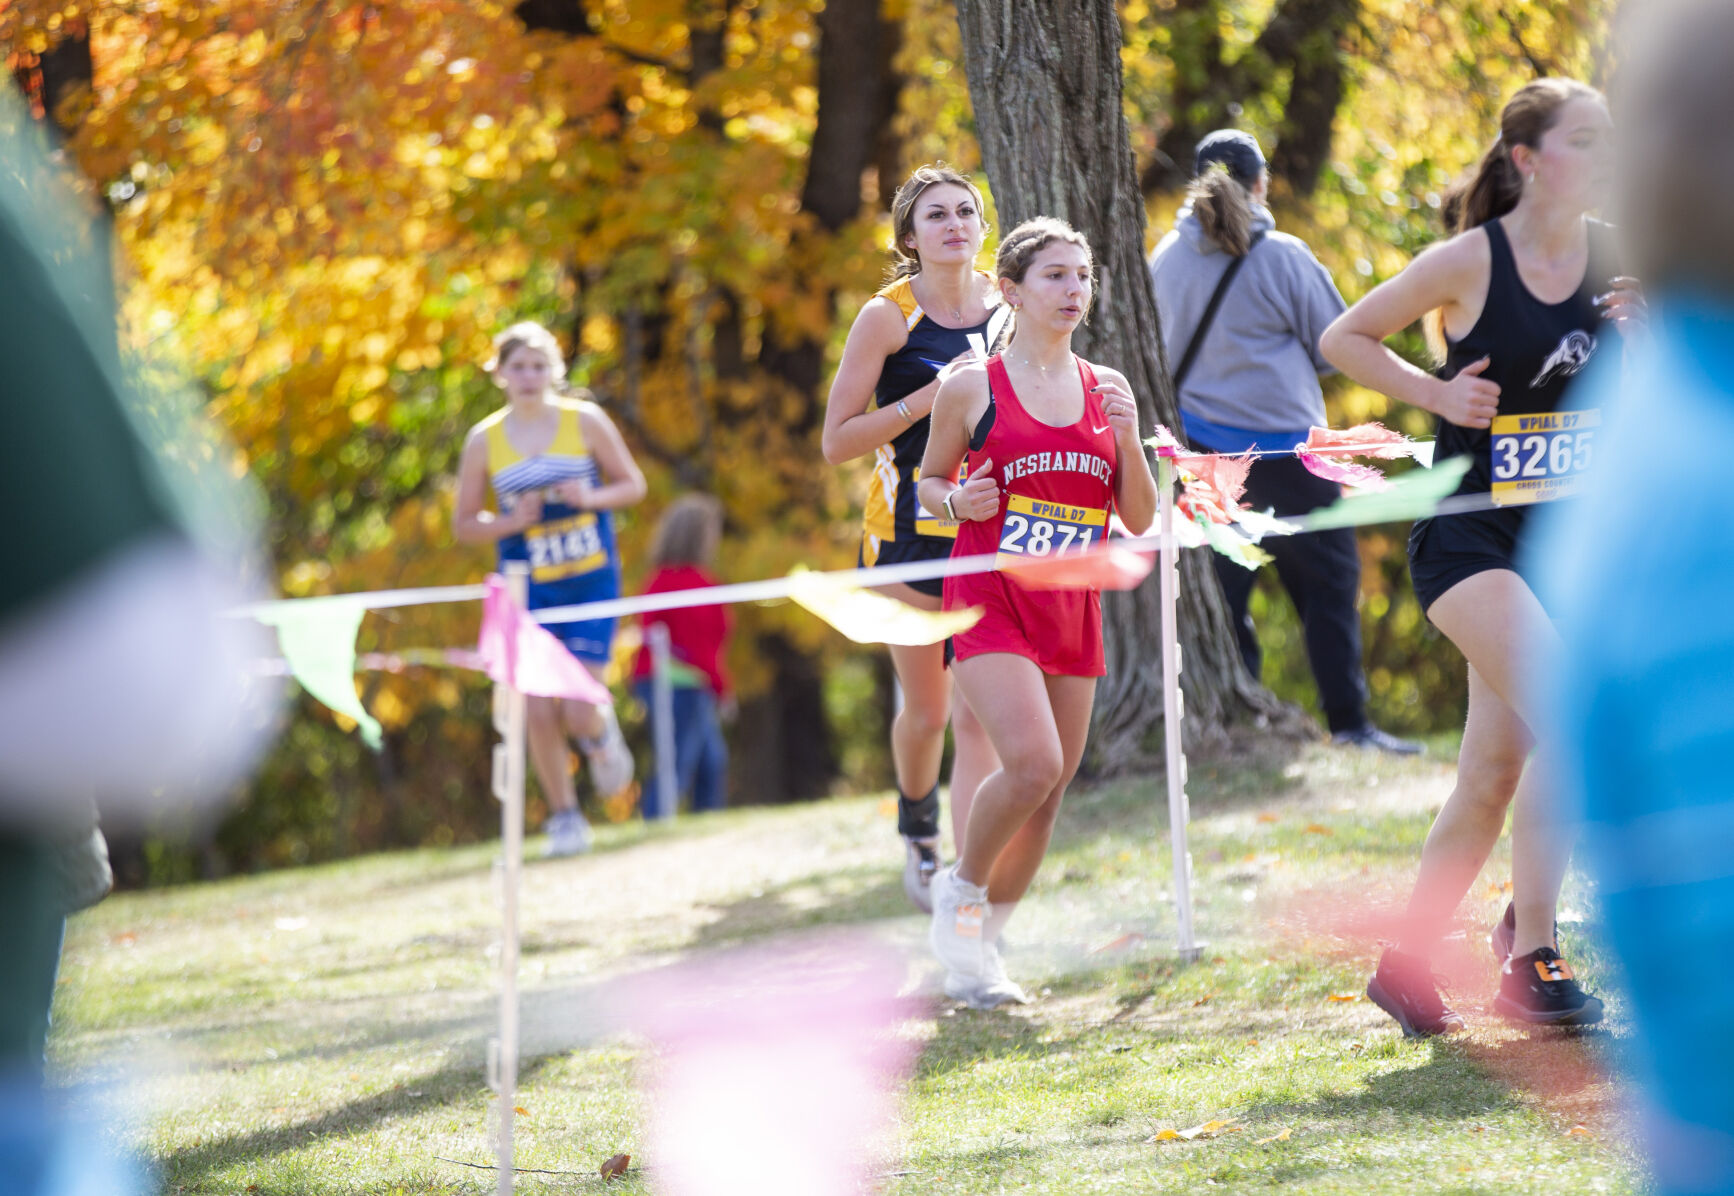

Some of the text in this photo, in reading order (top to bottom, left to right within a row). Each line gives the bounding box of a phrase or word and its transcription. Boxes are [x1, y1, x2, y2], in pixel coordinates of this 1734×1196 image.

[1519, 413, 1579, 430] WPIAL D7
[1494, 432, 1594, 479] 3265
[1032, 501, 1086, 521] WPIAL D7
[999, 514, 1093, 558] 2871
